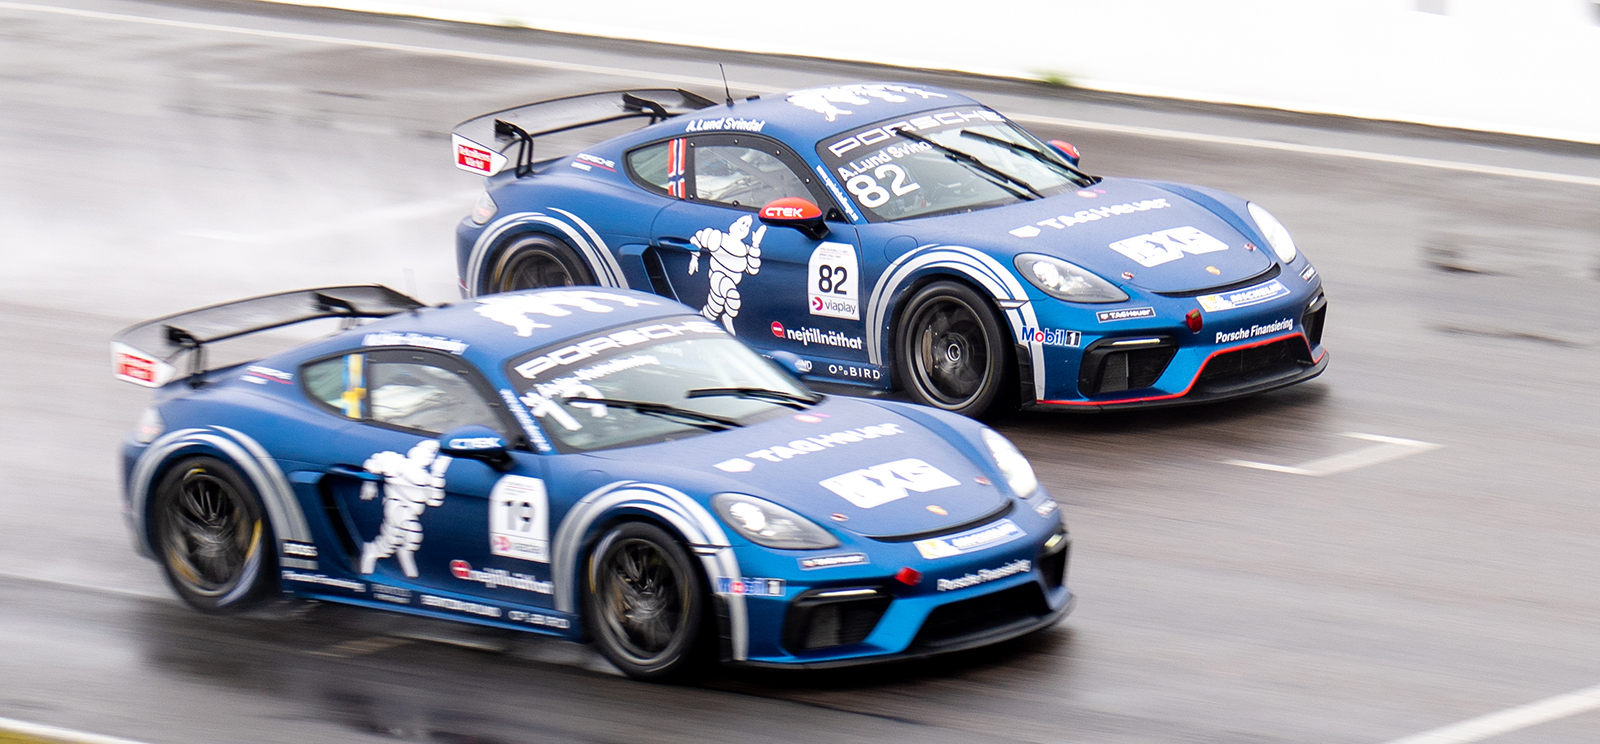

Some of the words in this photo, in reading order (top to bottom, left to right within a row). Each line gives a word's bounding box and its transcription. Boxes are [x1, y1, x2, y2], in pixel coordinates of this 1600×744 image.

[827, 110, 1007, 158] PORSCHE
[846, 163, 921, 209] 82
[765, 207, 804, 218] CTEK
[818, 264, 848, 295] 82
[824, 299, 857, 315] viaplay
[786, 327, 863, 350] nejtillnäthat
[1021, 327, 1065, 345] Mobil
[1215, 328, 1249, 344] Porsche
[1250, 318, 1294, 338] Finansiering
[514, 321, 726, 379] PORSCHE
